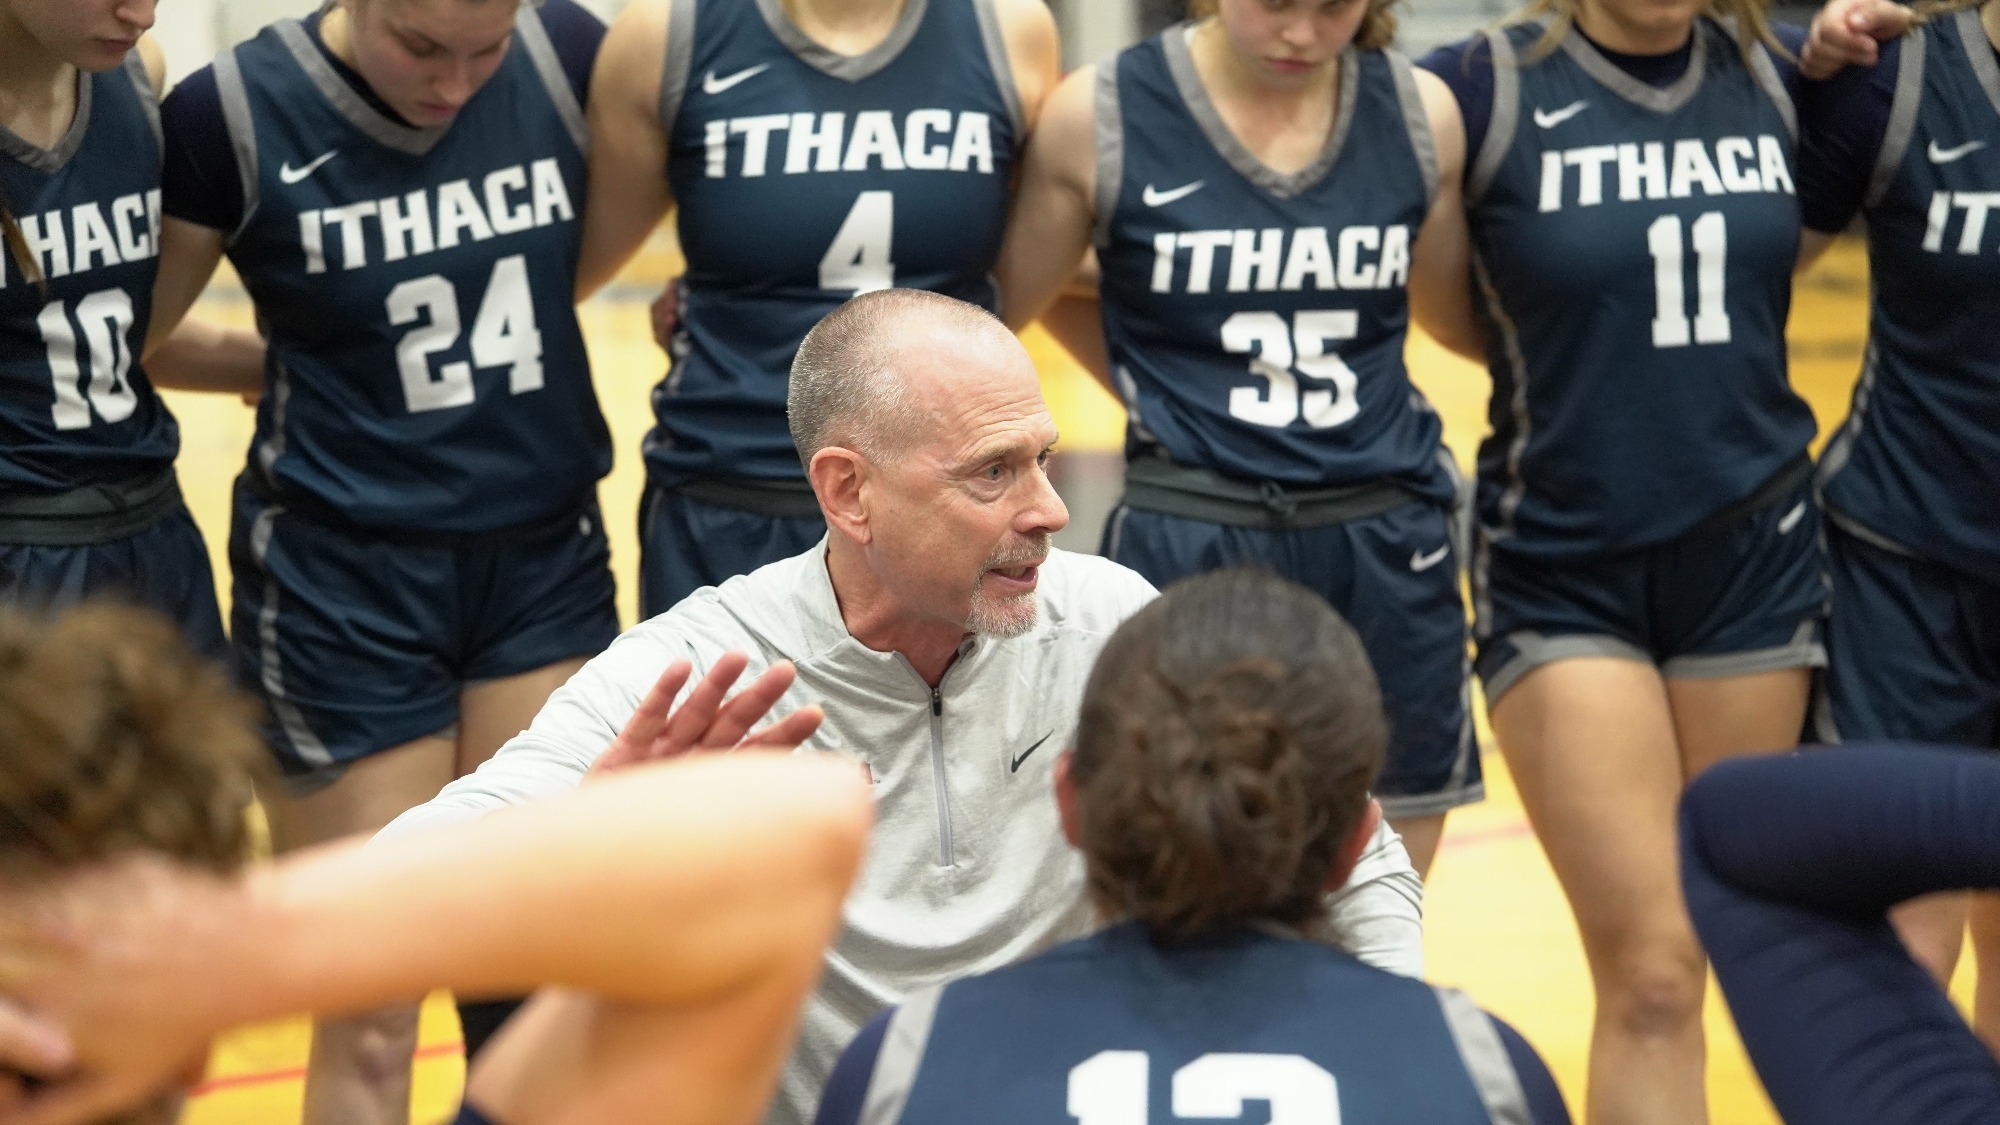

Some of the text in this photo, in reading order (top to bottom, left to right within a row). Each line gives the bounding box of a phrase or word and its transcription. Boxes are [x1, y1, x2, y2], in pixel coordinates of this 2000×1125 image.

[704, 108, 994, 178] ITHACA
[1538, 134, 1796, 213] ITHACA
[298, 157, 574, 273] ITHACA
[818, 190, 895, 298] 4
[1151, 224, 1410, 293] ITHACA
[1921, 190, 2000, 255] IT
[386, 254, 545, 412] 24
[1647, 211, 1732, 348] 11
[37, 288, 138, 430] 10
[1220, 310, 1360, 429] 35
